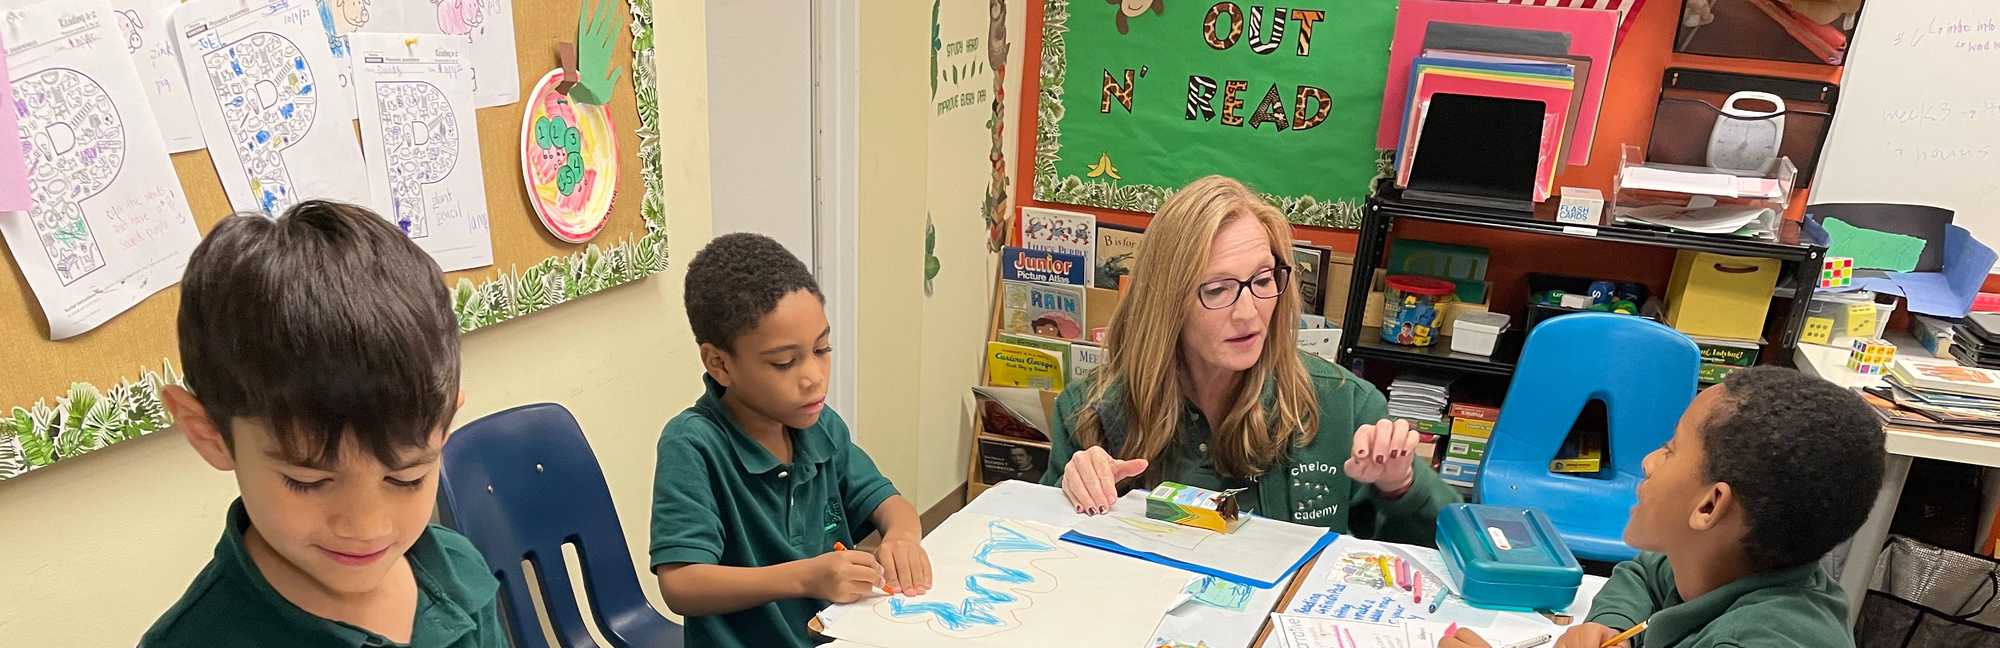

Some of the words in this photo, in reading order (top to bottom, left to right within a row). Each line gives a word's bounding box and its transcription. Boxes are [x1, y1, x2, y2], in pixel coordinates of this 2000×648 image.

[1203, 1, 1325, 57] OUT
[1100, 66, 1149, 114] N'
[1185, 75, 1333, 134] READ
[1104, 235, 1113, 247] B
[1123, 239, 1137, 249] for
[1014, 252, 1073, 275] Junior
[1017, 270, 1046, 281] Picture
[1048, 275, 1070, 285] Atlas
[1031, 290, 1076, 313] RAIN
[995, 352, 1025, 364] Curious
[1294, 504, 1338, 520] cademy
